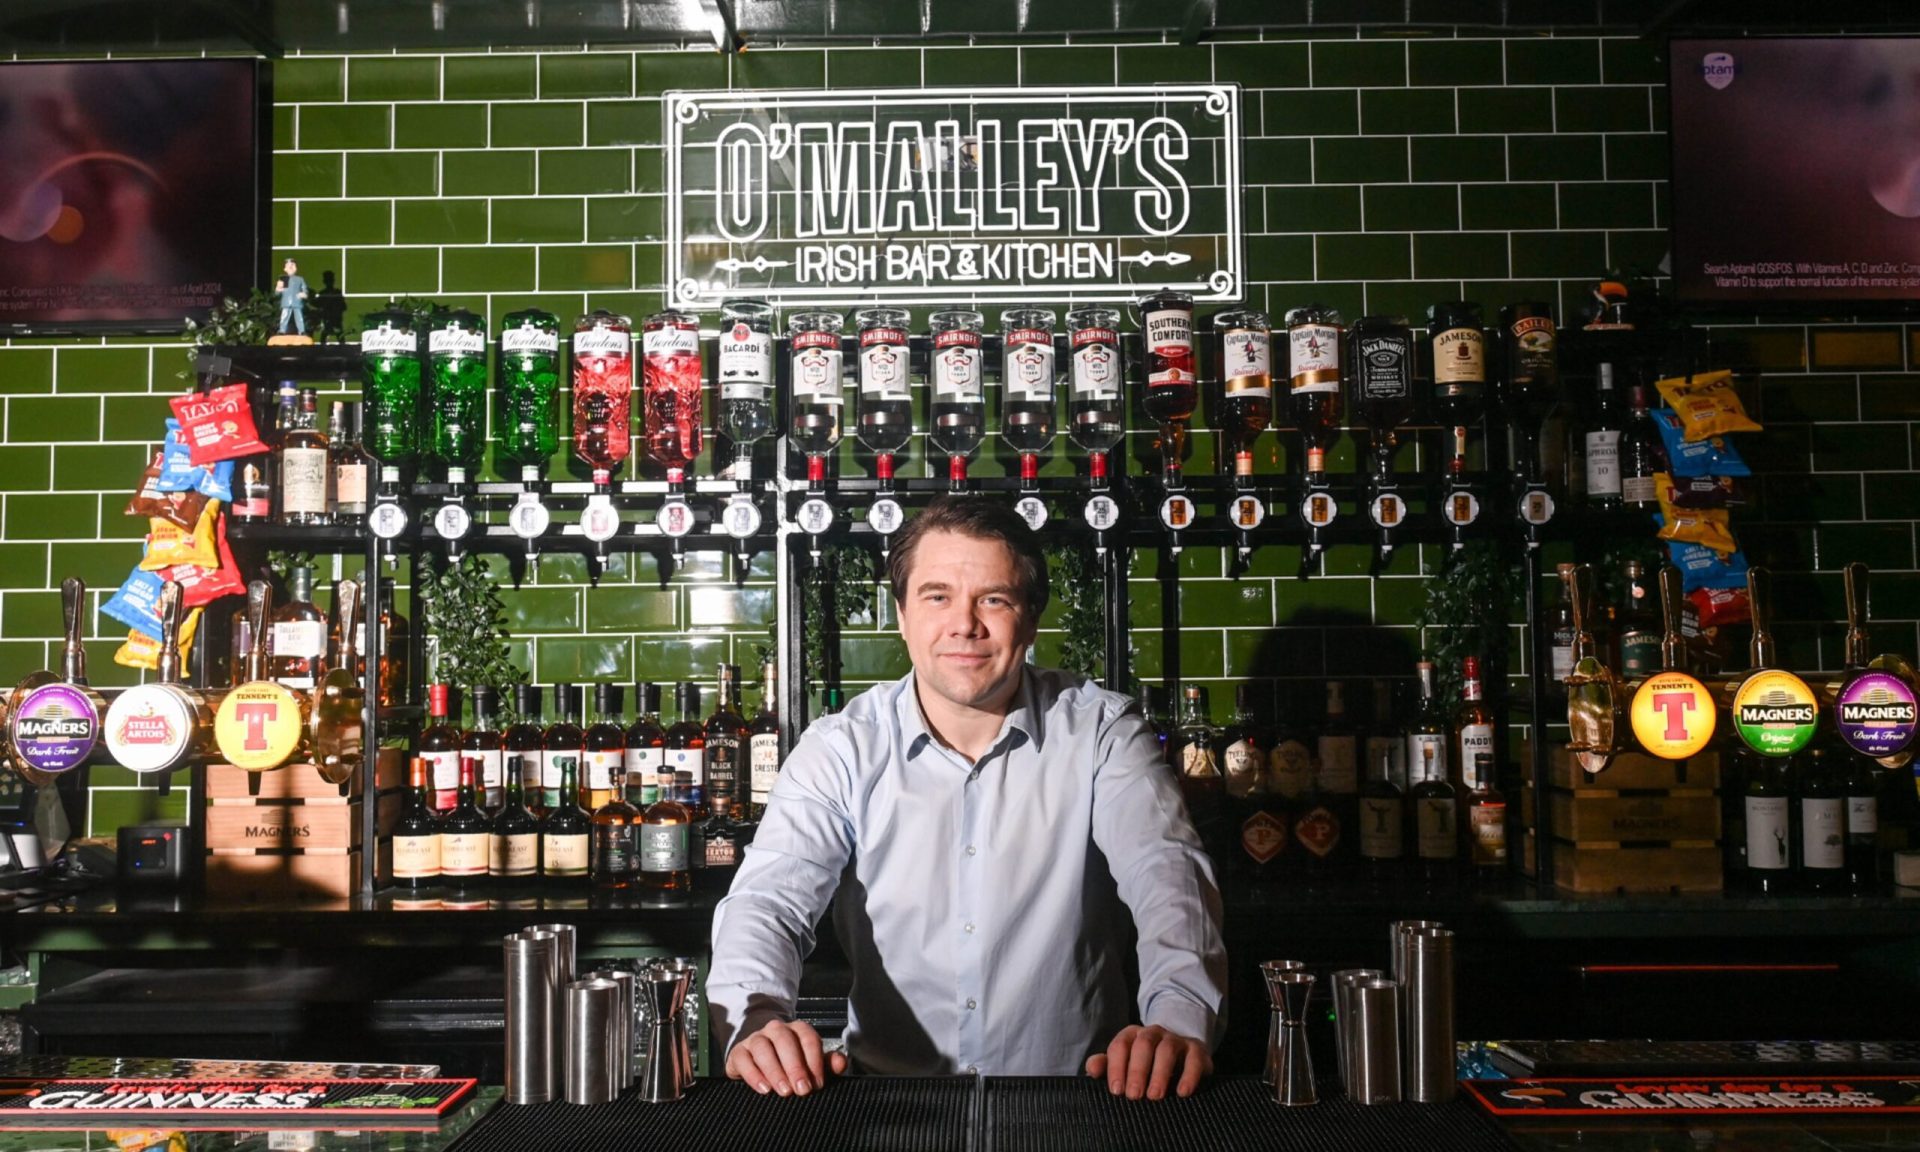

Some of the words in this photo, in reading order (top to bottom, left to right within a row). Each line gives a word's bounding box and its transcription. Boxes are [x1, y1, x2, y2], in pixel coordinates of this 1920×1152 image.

[796, 246, 877, 282] IRISH
[887, 245, 950, 281] BAR
[950, 244, 982, 281] &
[982, 242, 1113, 280] KITCHEN
[1704, 262, 1728, 274] Search
[796, 334, 835, 346] SMIRNOFF
[863, 332, 903, 343] SMIRNOFF
[938, 333, 977, 344] SMIRNOFF
[1010, 332, 1050, 342] SMIRNOFF
[1075, 330, 1115, 341] SMIRNOFF
[1226, 334, 1249, 345] Captain
[1291, 331, 1313, 342] Captain
[1362, 343, 1380, 356] JACK
[1597, 467, 1609, 475] 10
[1653, 692, 1696, 741] T
[1743, 707, 1813, 721] MAGNERS
[1844, 706, 1914, 720] MAGNERS
[19, 721, 89, 735] MAGNERS
[127, 721, 165, 730] STELLA
[235, 703, 277, 751] T
[127, 730, 165, 738] ARTOIS
[1853, 730, 1879, 740] Dark
[1880, 730, 1906, 740] Fruit
[705, 739, 739, 748] JAMESON
[26, 746, 52, 756] Dark
[53, 745, 79, 756] Fruit
[754, 764, 779, 772] CRESTE
[710, 772, 734, 780] BARREL
[245, 825, 310, 837] MAGNERS
[29, 1091, 312, 1109] GUINNESS
[1579, 1091, 1885, 1109] GUINNESS
